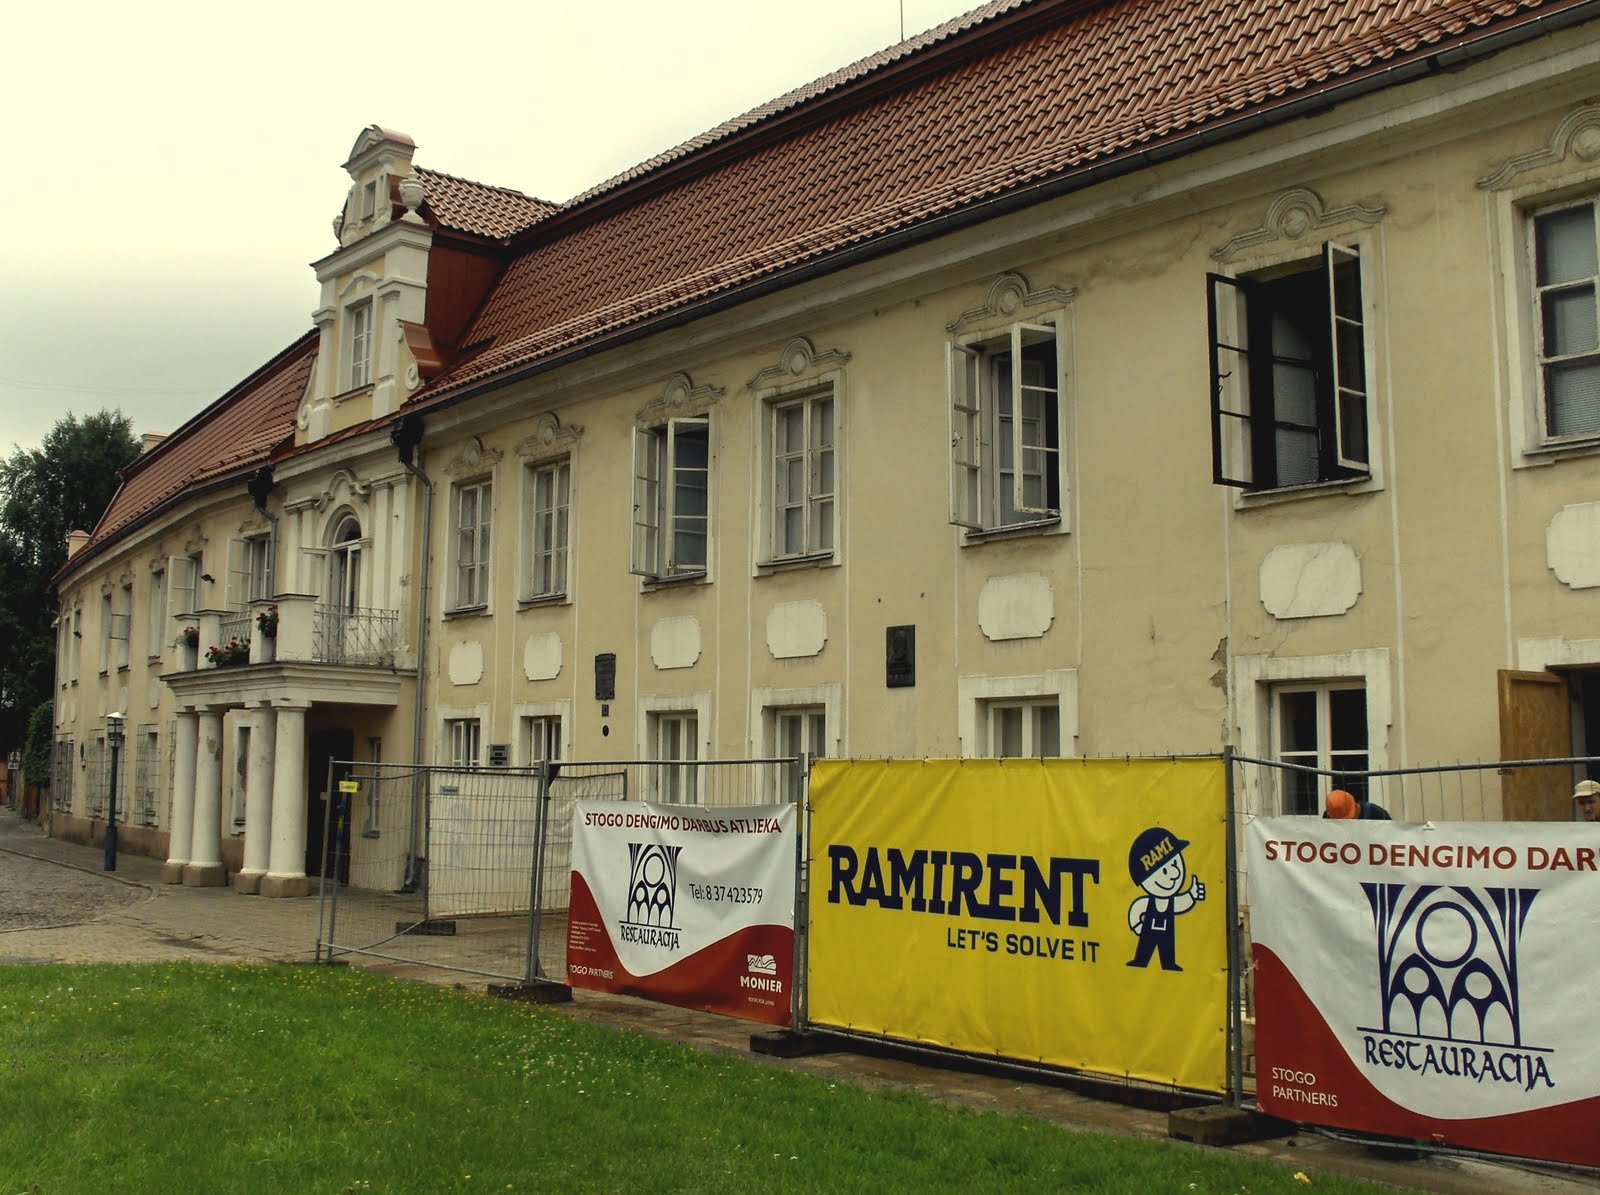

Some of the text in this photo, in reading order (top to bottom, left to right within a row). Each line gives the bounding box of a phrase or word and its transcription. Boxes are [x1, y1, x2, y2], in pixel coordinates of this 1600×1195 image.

[585, 813, 782, 834] STOGO DENGIMO DARBUS ATLIEKA
[1140, 837, 1174, 871] RAMI
[1265, 840, 1600, 872] STOGO DENGIMO DAR
[828, 844, 1100, 928] RAMIRENT
[620, 925, 680, 951] RESTAURACIJA
[947, 928, 1100, 963] LET'S SOLVE IT
[740, 975, 782, 993] MONIER
[1272, 1067, 1316, 1086] STOGO
[1363, 1036, 1555, 1092] RESTAURACIJA
[1273, 1086, 1338, 1107] PARTNERIS
